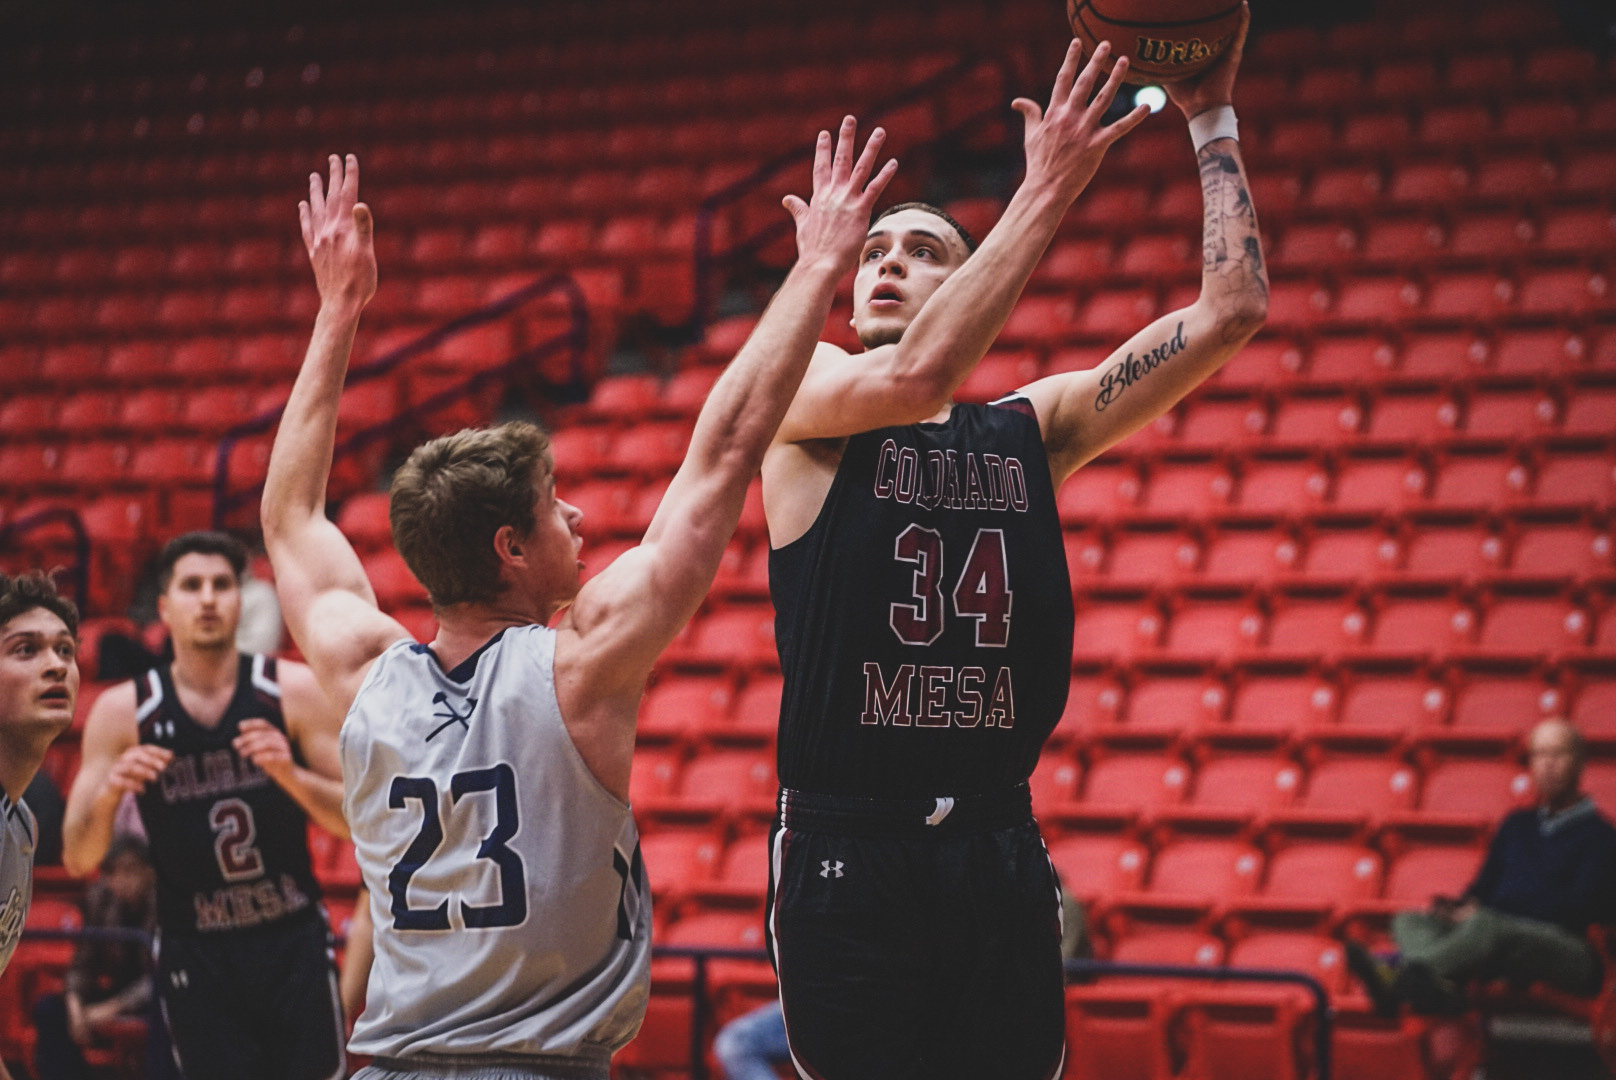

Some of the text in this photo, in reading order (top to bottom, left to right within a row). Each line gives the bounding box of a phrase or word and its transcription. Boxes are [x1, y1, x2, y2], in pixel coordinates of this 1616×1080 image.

[1136, 36, 1222, 65] Wils
[1095, 321, 1187, 411] Blessed
[889, 522, 1013, 647] 34
[861, 662, 1015, 728] MESA
[208, 797, 264, 882] 2
[389, 764, 528, 931] 23
